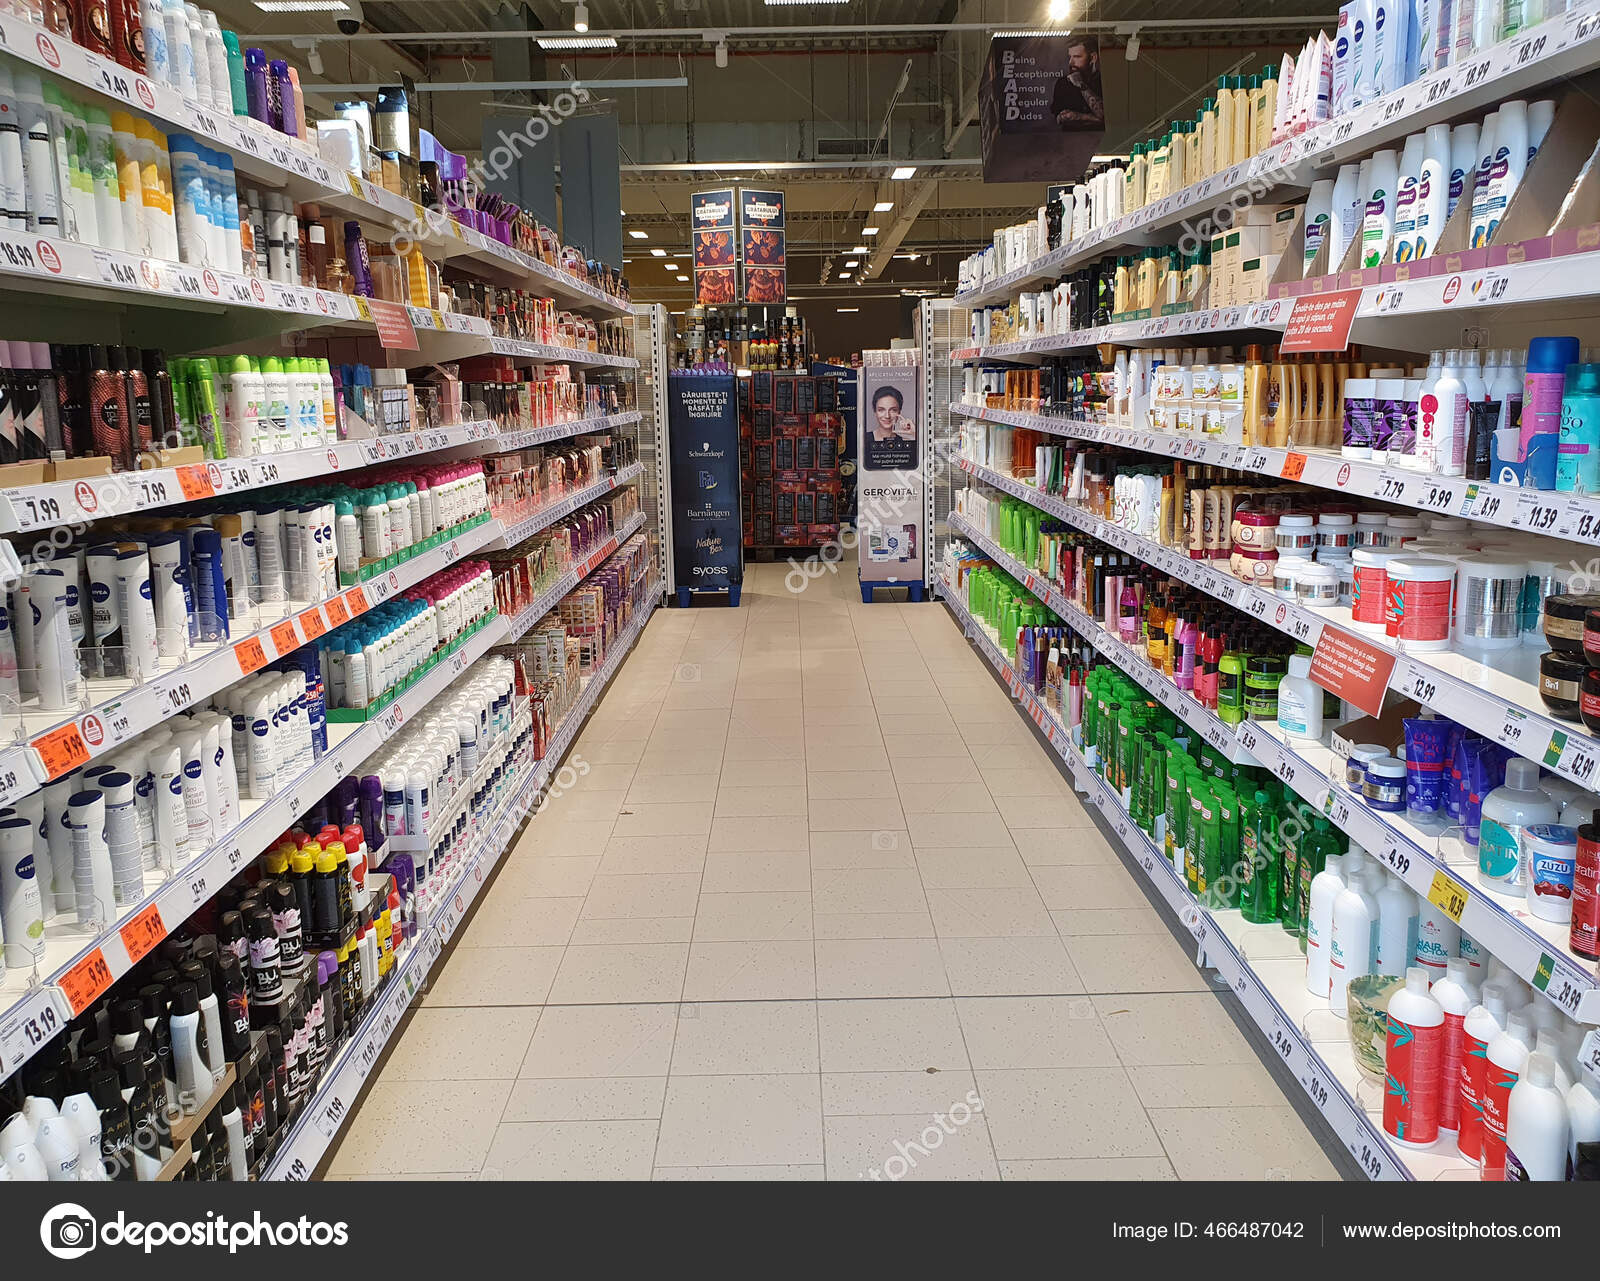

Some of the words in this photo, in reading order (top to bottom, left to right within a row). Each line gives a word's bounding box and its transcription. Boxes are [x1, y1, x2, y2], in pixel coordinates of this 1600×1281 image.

[1002, 50, 1036, 65] Being
[1517, 35, 1547, 64] 18.99
[1003, 65, 1064, 80] Exceptional
[1464, 61, 1490, 87] 18.99
[102, 71, 130, 98] 9.49
[1004, 79, 1046, 94] Among
[1427, 78, 1450, 103] 18.99
[1005, 93, 1049, 107] Regular
[1006, 107, 1043, 120] Dudes
[1, 242, 35, 267] 18.99
[111, 263, 137, 284] 16.49
[688, 450, 724, 458] Schwarzkopf
[1252, 455, 1265, 470] 6.39
[231, 469, 249, 487] 5.49
[261, 464, 279, 481] 5.49
[141, 482, 166, 503] 7.99
[863, 488, 918, 497] GEROVITAL
[1383, 480, 1405, 498] 7.79
[1428, 488, 1452, 508] 9.99
[26, 498, 60, 523] 7.99
[1481, 496, 1500, 517] 8.99
[1529, 507, 1557, 528] 11.39
[695, 536, 722, 549] Nature
[692, 566, 728, 577] syoss
[1251, 599, 1266, 615] 6.39
[1294, 621, 1309, 638] 16.99
[1413, 679, 1435, 701] 12.99
[1545, 678, 1559, 691] 8in1
[169, 683, 192, 709] 10.99
[113, 717, 129, 732] 11.99
[1503, 723, 1521, 740] 42.99
[63, 733, 85, 761] 9.99
[1242, 732, 1256, 750] 8.59
[1549, 740, 1562, 756] Nou
[1279, 763, 1295, 782] 8.99
[1571, 753, 1594, 780] 42.99
[1388, 848, 1410, 875] 4.99
[1541, 860, 1569, 873] ZUZU
[191, 878, 206, 895] 12.99
[1448, 894, 1465, 918] 10.39
[145, 913, 163, 939] 9.99
[88, 958, 109, 987] 9.99
[1537, 962, 1550, 980] Nou
[1558, 981, 1581, 1012] 29.99
[25, 1006, 56, 1046] 13.19
[1275, 1031, 1292, 1057] 9.49
[1310, 1078, 1328, 1107] 10.99
[326, 1096, 345, 1123] 11.99
[1361, 1145, 1381, 1178] 14.99
